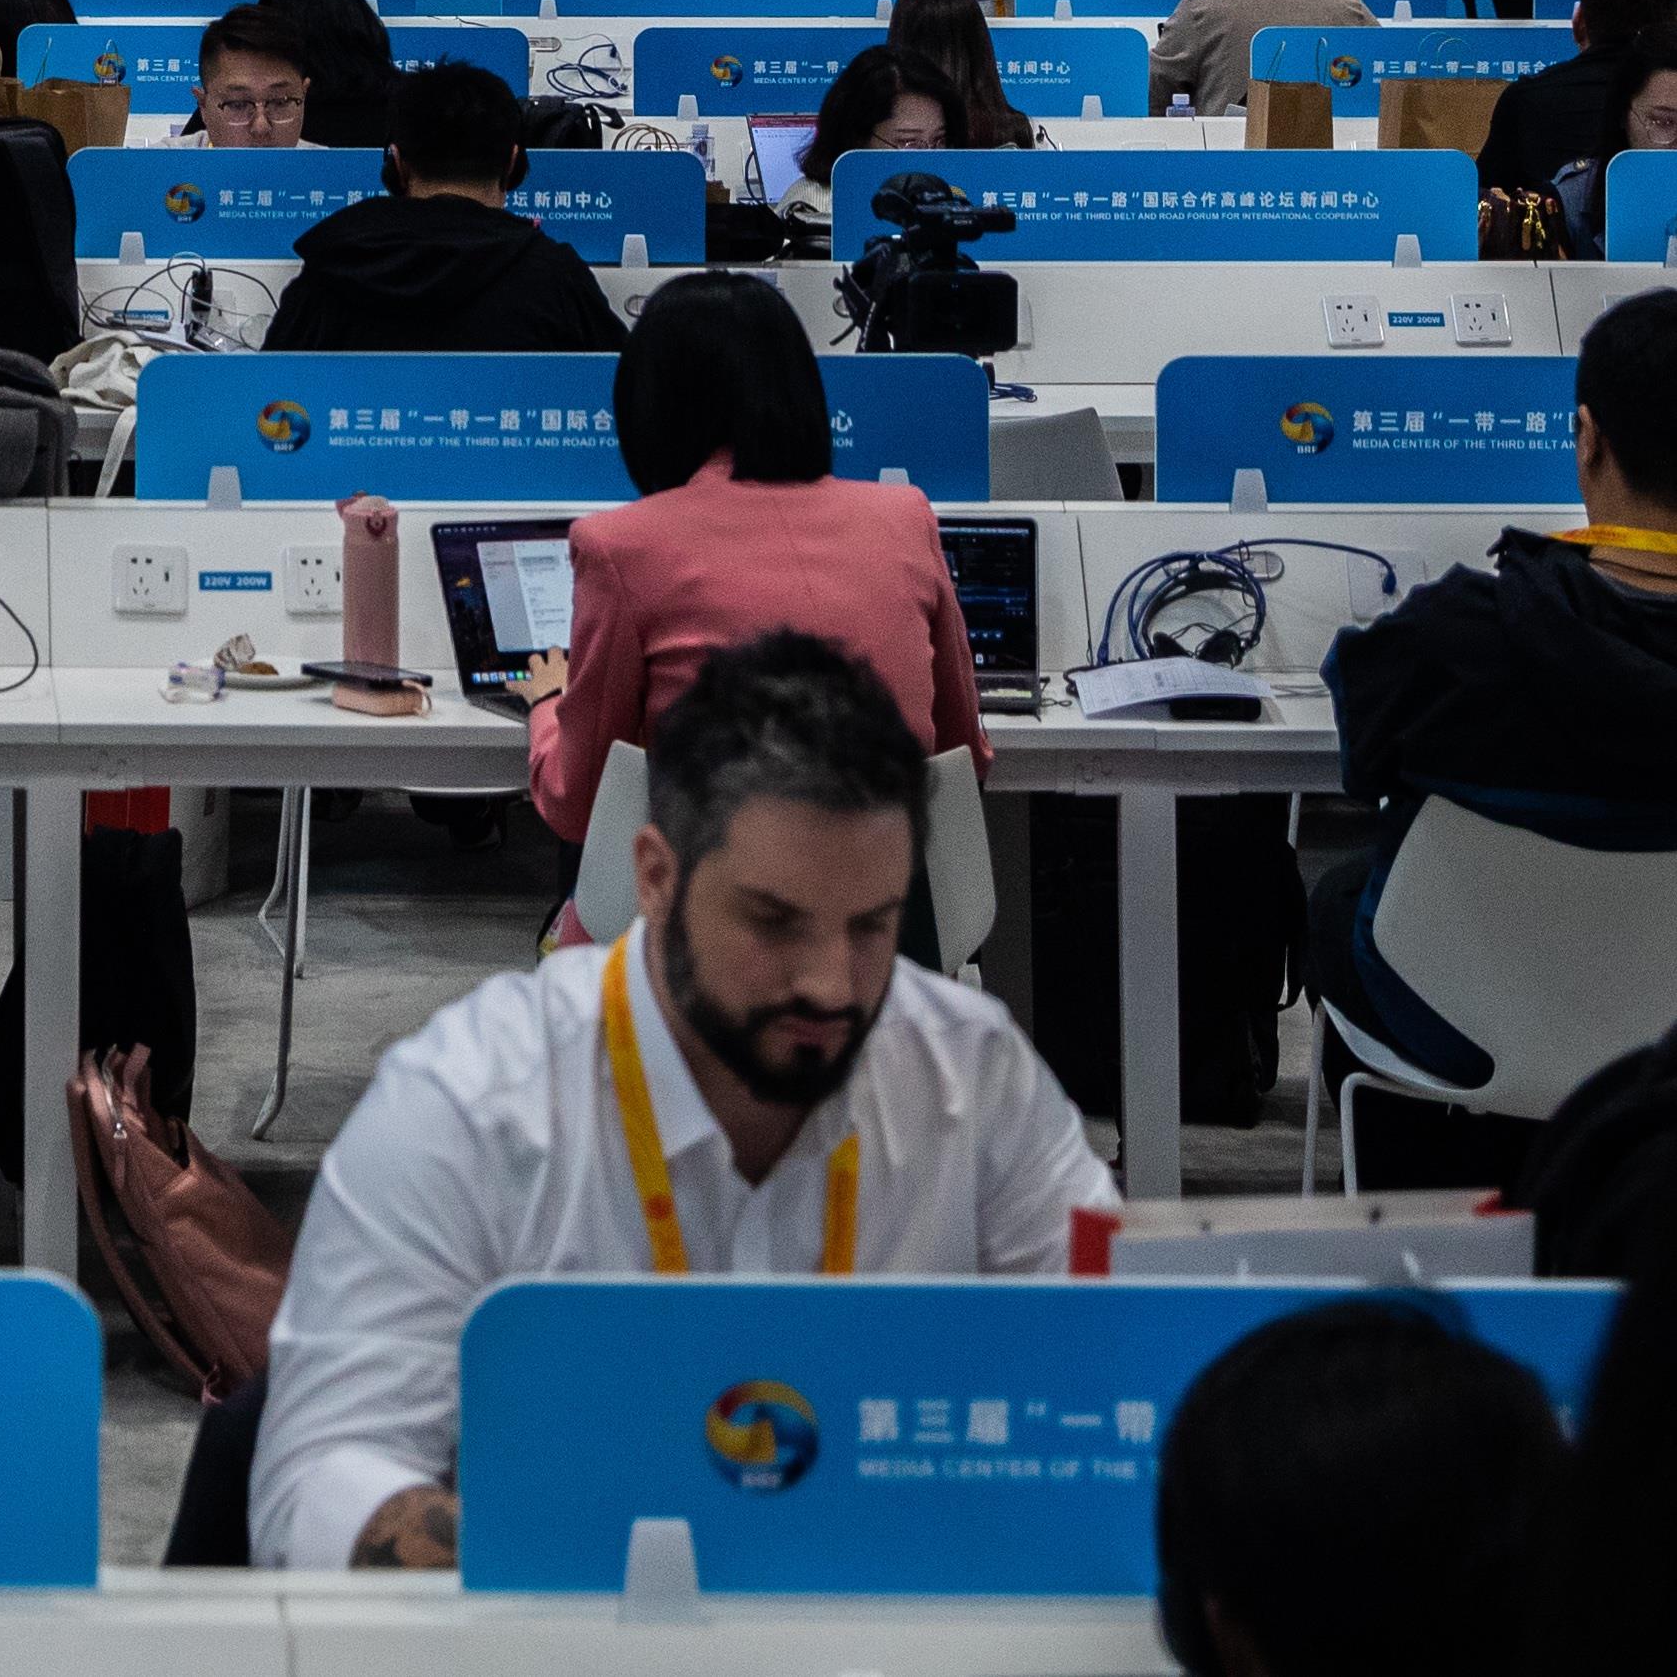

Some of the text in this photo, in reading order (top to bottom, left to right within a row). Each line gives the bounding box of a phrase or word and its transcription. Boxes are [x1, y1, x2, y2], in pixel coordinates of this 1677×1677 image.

[547, 212, 613, 220] COOPERATION
[1065, 212, 1083, 221] THE
[1084, 212, 1111, 221] THIRD
[1113, 212, 1135, 221] BELT
[1137, 212, 1158, 220] AND
[1158, 212, 1185, 220] ROAD
[1186, 212, 1220, 220] FORUM
[1221, 212, 1241, 220] FOR
[1242, 212, 1313, 220] INTERNATIONAL
[1314, 212, 1380, 220] COOPERATION
[1392, 315, 1441, 325] 220V 200W
[329, 436, 366, 447] MEDIA
[368, 436, 417, 447] CENTER
[439, 436, 462, 447] THE
[465, 436, 499, 447] THIRD
[501, 436, 532, 447] BELT
[534, 437, 560, 447] AND
[562, 437, 597, 447] ROAD
[1352, 438, 1578, 450] MEDIA CENTER OF THE THIRD BELT AN
